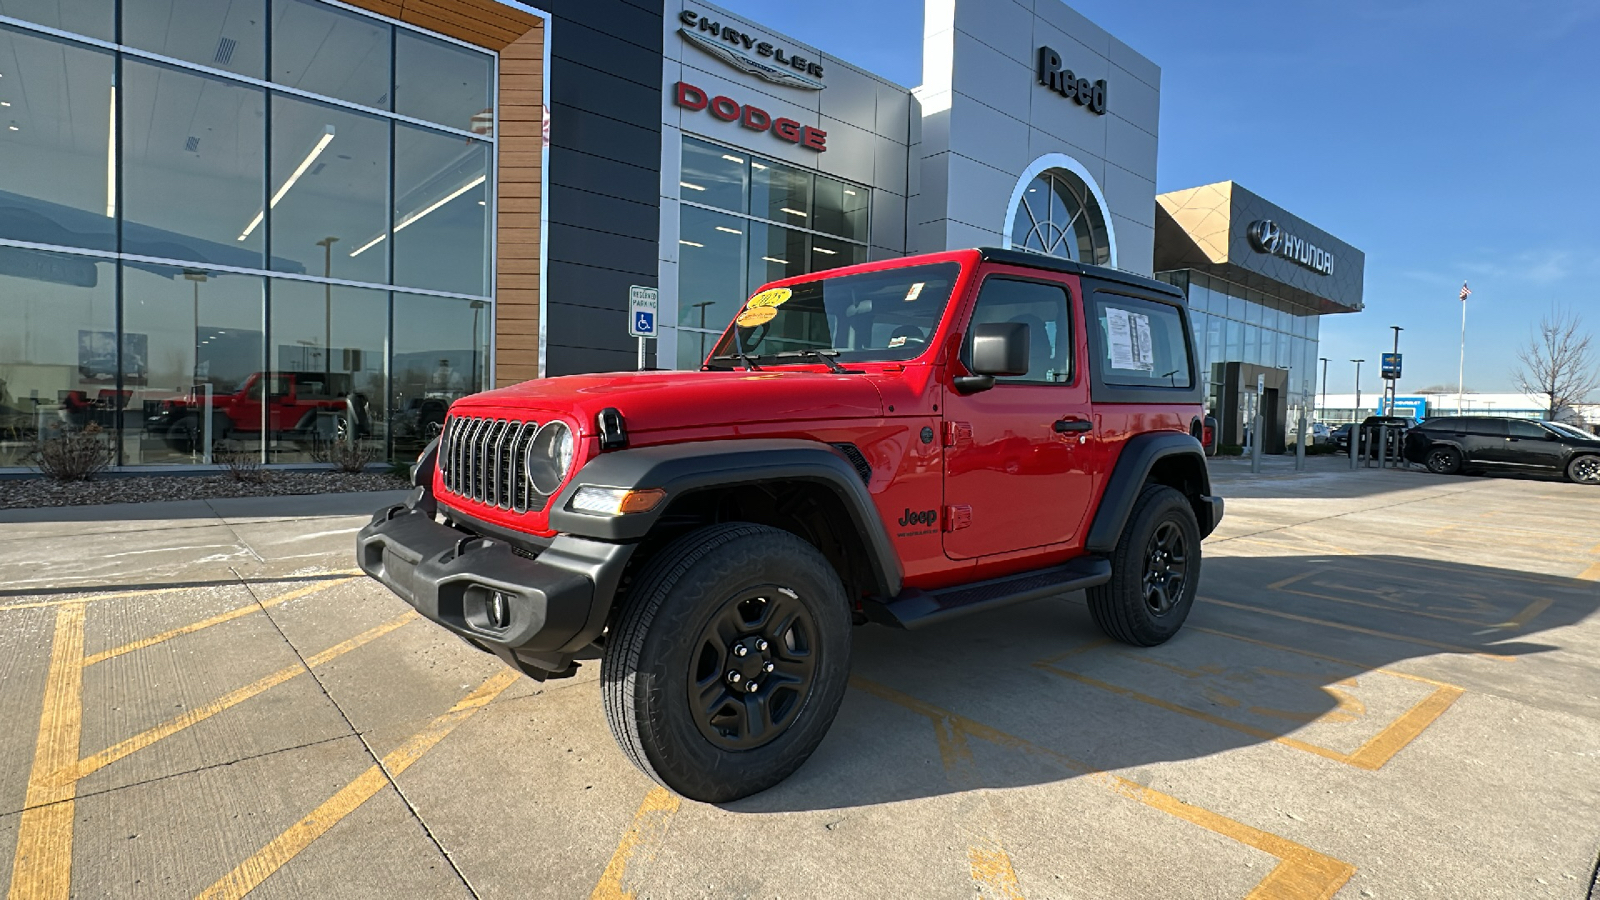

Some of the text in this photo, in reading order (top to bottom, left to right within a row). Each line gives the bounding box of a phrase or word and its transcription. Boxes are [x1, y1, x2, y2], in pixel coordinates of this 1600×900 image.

[680, 9, 824, 78] CHRYSLER
[1038, 45, 1107, 115] Reed
[675, 81, 827, 152] DODGE
[1284, 232, 1334, 275] HYUNDAI
[633, 291, 656, 300] RESERVED
[633, 299, 656, 308] PARKING
[898, 508, 937, 527] Jeep
